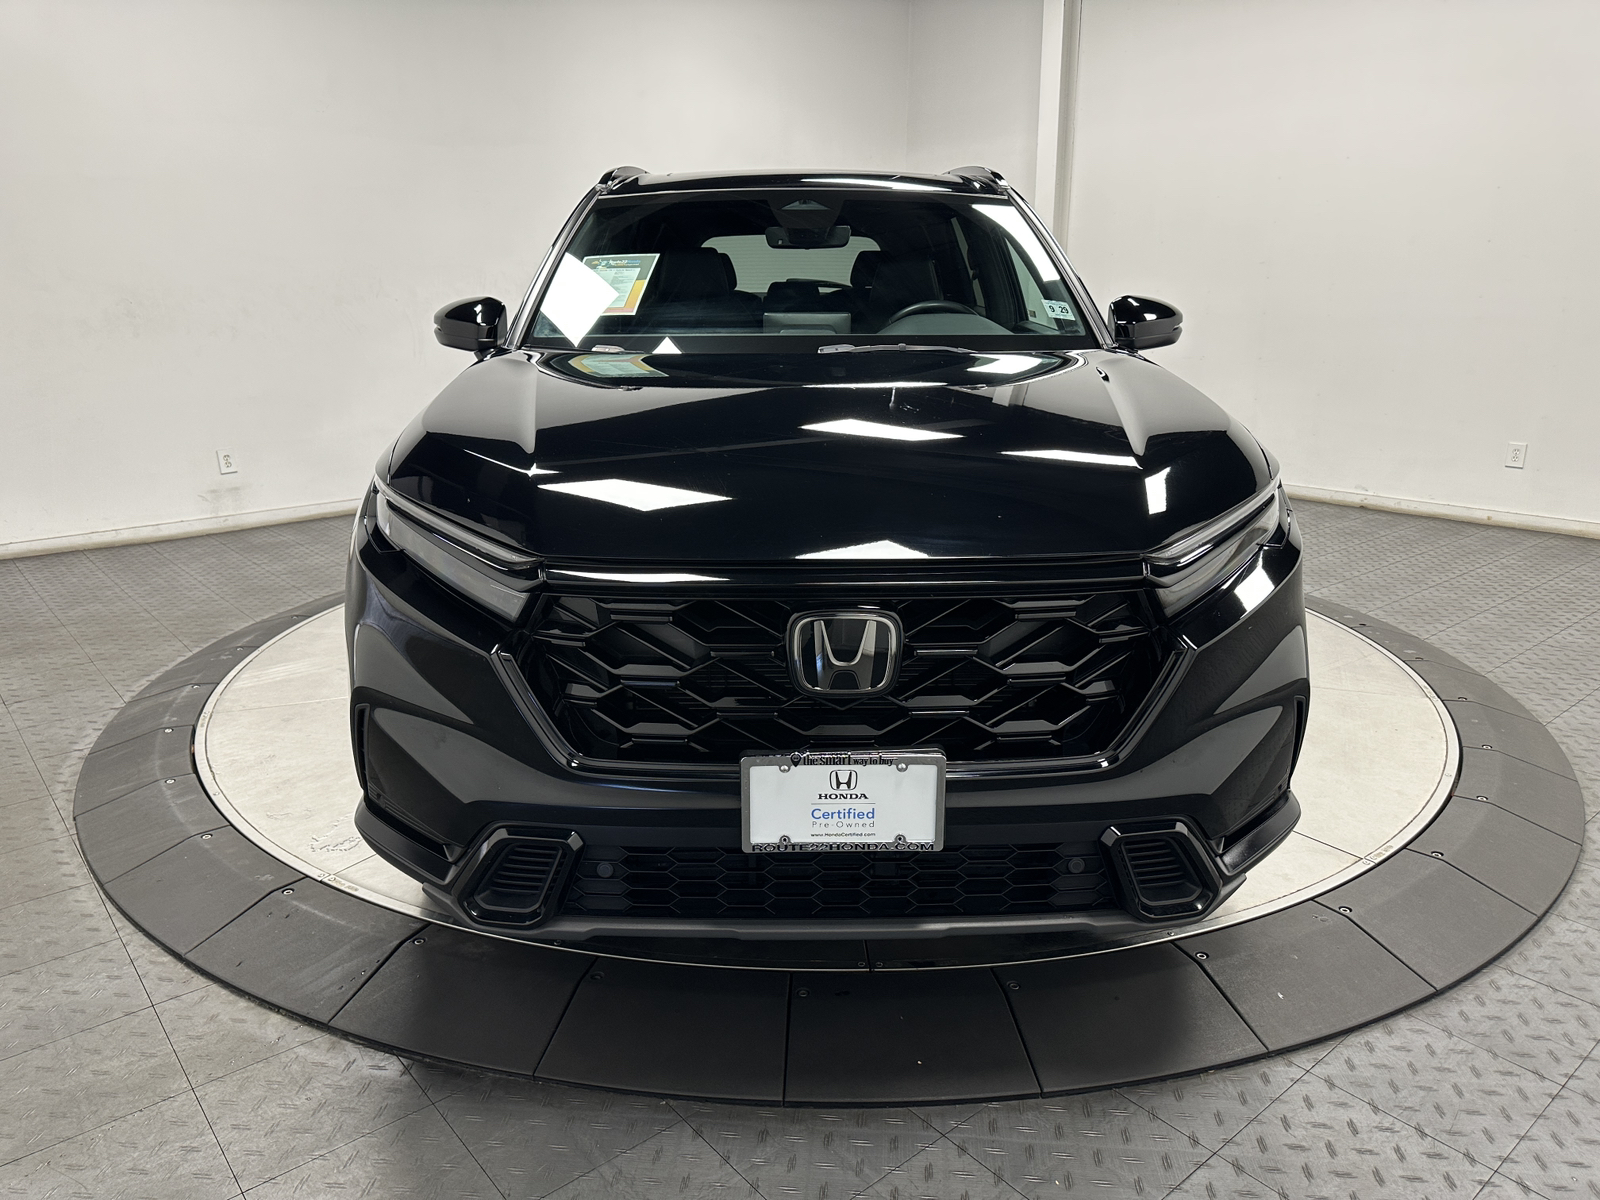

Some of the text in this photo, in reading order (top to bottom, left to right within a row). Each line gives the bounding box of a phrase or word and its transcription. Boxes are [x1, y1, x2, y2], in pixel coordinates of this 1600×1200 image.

[803, 754, 894, 767] the smart way to buy
[811, 808, 875, 820] Certified
[811, 821, 875, 829] Pre-Owned
[752, 842, 935, 852] ROUTE22HONDA.COM
